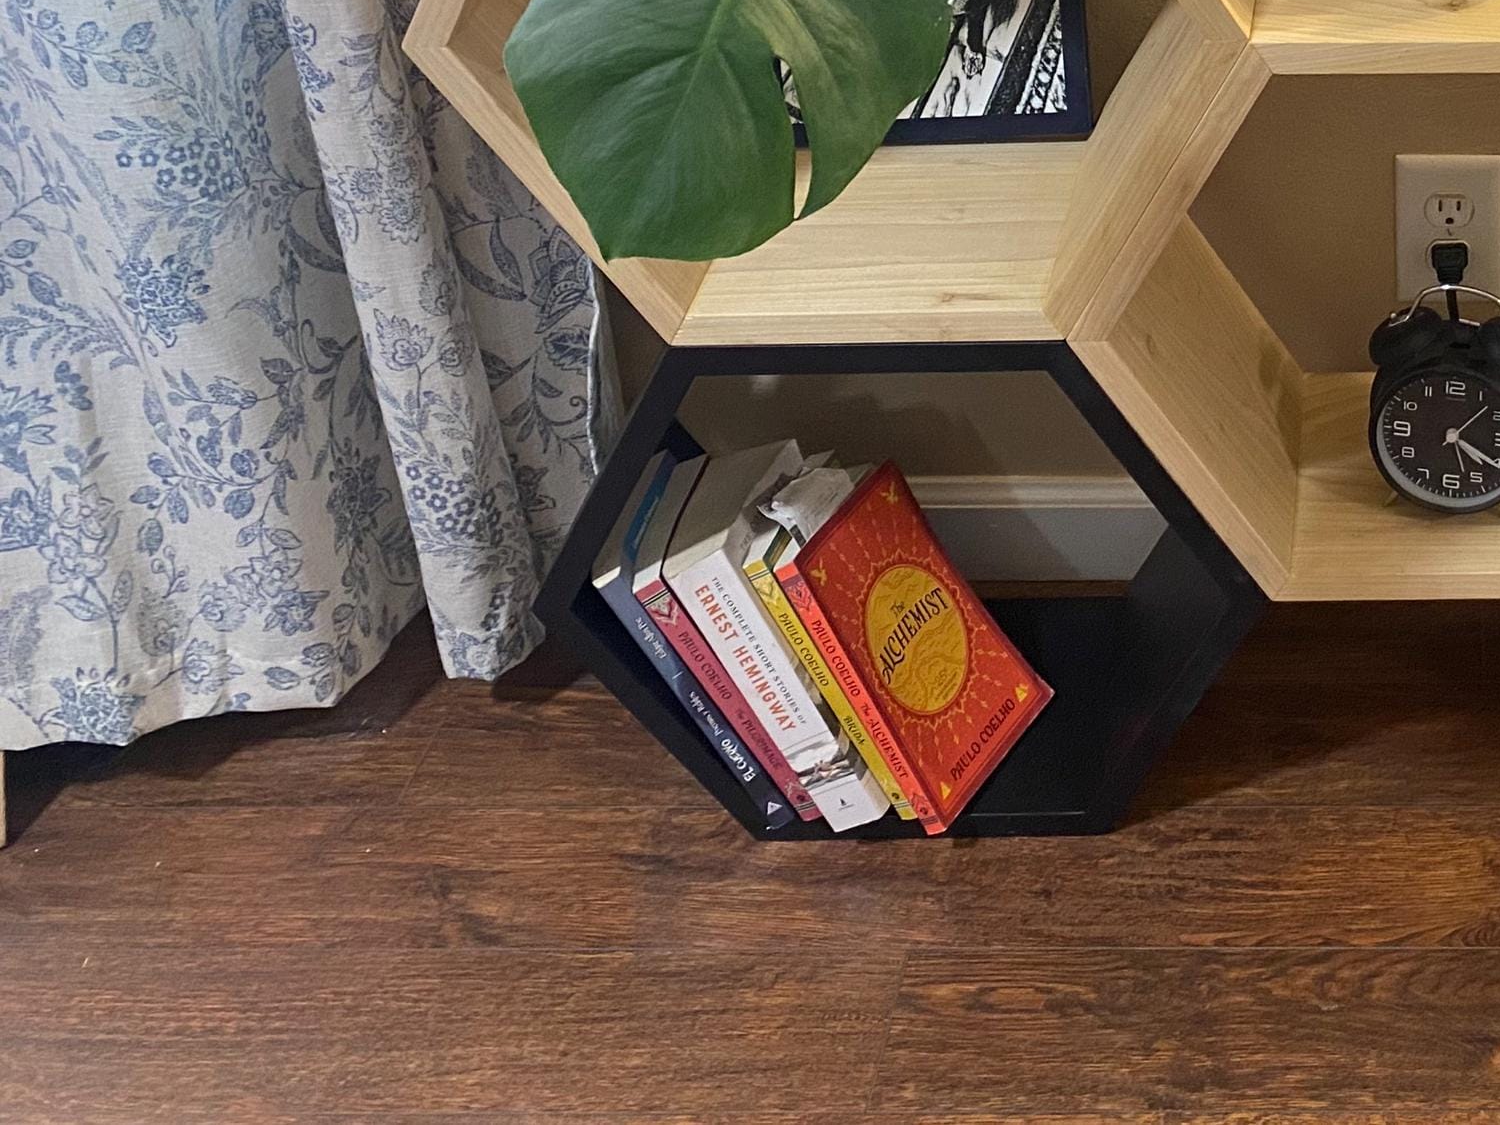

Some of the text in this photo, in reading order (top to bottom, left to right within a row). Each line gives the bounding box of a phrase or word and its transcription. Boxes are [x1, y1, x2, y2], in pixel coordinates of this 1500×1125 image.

[1445, 380, 1466, 396] 12
[1403, 401, 1417, 411] 10
[1393, 421, 1411, 436] 9
[1402, 446, 1414, 458] 8
[1417, 467, 1429, 479] 7
[1442, 474, 1460, 489] 6
[1470, 471, 1483, 483] 5
[889, 601, 905, 618] The
[879, 587, 949, 685] ALCHEMIST
[711, 577, 724, 593] THE
[722, 593, 757, 644] COMPLETE
[753, 644, 777, 674] SHORT
[773, 675, 802, 713] STORIES
[678, 631, 705, 662] PAULO
[702, 660, 732, 700] COELHO
[694, 585, 797, 731] ERNEST HEMINGWAY
[778, 612, 865, 747] PAULO COELHO BRIDA
[811, 619, 909, 779] PAULO COELHO The ALCHEMIST
[950, 698, 1016, 781] PAULO COELHO
[743, 765, 757, 782] EL
